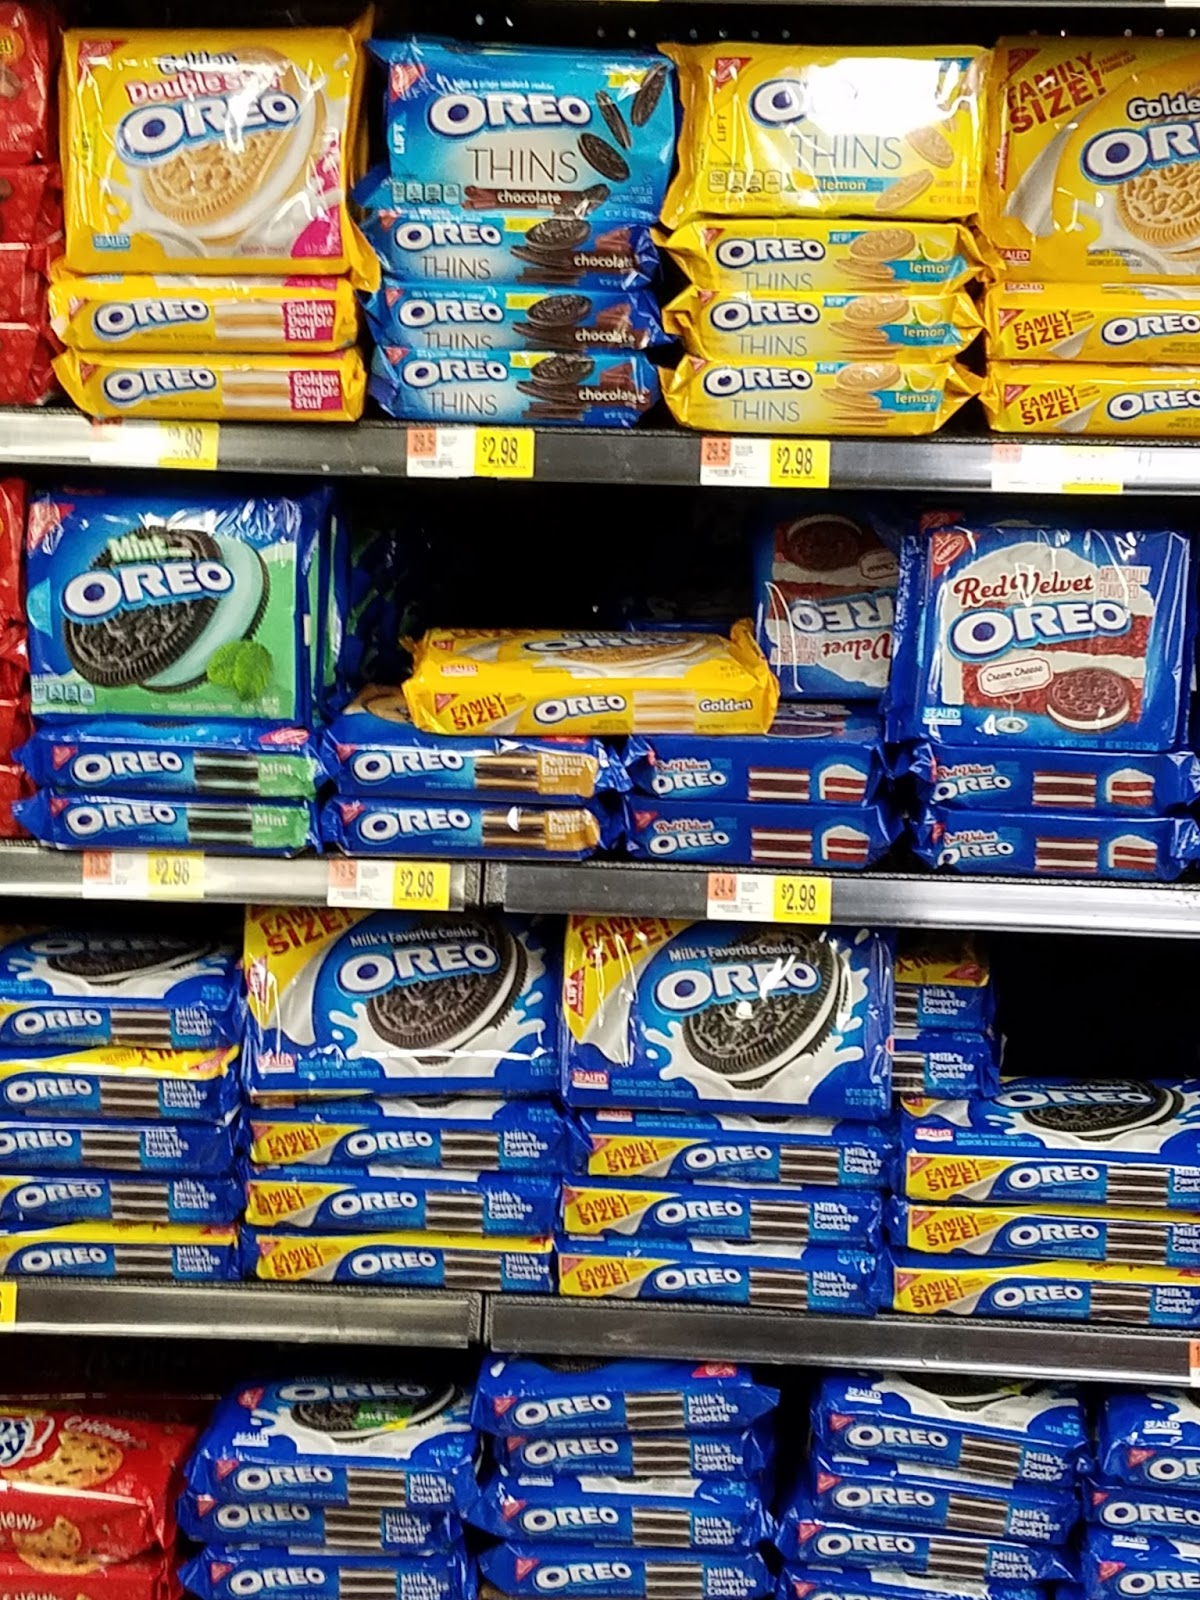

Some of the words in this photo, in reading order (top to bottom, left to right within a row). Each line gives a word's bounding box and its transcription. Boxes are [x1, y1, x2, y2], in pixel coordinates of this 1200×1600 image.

[127, 71, 223, 105] Double
[1006, 52, 1096, 110] FAMILY
[428, 91, 592, 137] OREO
[1010, 70, 1107, 134] SIZE!
[120, 93, 299, 155] OREO
[717, 115, 727, 142] LIFT
[392, 122, 406, 154] LIFT
[791, 133, 902, 171] THINS
[466, 147, 579, 184] THINS
[822, 179, 867, 191] lemon
[497, 190, 562, 206] chocolate
[396, 222, 501, 250] OREO
[716, 238, 826, 269] OREO
[421, 256, 492, 279] THINS
[742, 271, 813, 291] THINS
[94, 300, 210, 337] OREO
[287, 302, 333, 316] Golden
[288, 315, 334, 327] Double
[400, 299, 503, 327] OREO
[710, 302, 820, 332] OREO
[288, 326, 316, 340] Stuf
[903, 326, 946, 339] lemon
[1013, 310, 1071, 336] FAMILY
[1101, 314, 1200, 346] OREO
[422, 331, 493, 350] THINS
[737, 334, 808, 356] THINS
[1015, 321, 1075, 351] SIZE!
[104, 368, 217, 404] OREO
[292, 372, 339, 387] Golden
[403, 360, 508, 388] OREO
[703, 367, 813, 397] OREO
[294, 385, 340, 398] Double
[294, 397, 323, 410] Stuf
[427, 391, 498, 416] THINS
[895, 392, 937, 405] lemon
[1020, 385, 1077, 412] FAMILY
[730, 399, 801, 423] THINS
[1021, 396, 1081, 426] SIZE!
[482, 437, 519, 466] $2.98
[776, 445, 813, 476] $2.98
[108, 532, 167, 562] Mint
[62, 558, 235, 620] OREO
[953, 574, 1008, 607] Red
[1010, 570, 1094, 602] Velvet
[952, 601, 1130, 656] OREO
[822, 633, 892, 661] Velvet
[986, 668, 1014, 683] Cream
[1014, 664, 1044, 678] Cheese
[533, 694, 627, 724] OREO
[699, 698, 753, 713] Golden
[73, 751, 184, 784] OREO
[260, 761, 295, 775] Mint
[353, 749, 464, 782] OREO
[541, 754, 588, 768] Peanut
[541, 764, 584, 777] Butter
[652, 771, 727, 795] OREO
[931, 775, 1012, 804] OREO
[66, 804, 177, 837] OREO
[254, 813, 289, 827] Mint
[360, 807, 472, 842] OREO
[650, 831, 731, 855] OREO
[938, 843, 1015, 867] OREO
[155, 858, 191, 886] $2.98
[400, 870, 435, 899] $2.98
[781, 883, 817, 912] $2.98
[351, 934, 387, 949] Milk's
[389, 930, 438, 944] Favorite
[440, 926, 479, 940] Cookie
[669, 947, 707, 962] Milk's
[708, 944, 757, 958] Favorite
[758, 943, 801, 956] Cookie
[339, 943, 498, 994] OREO
[922, 988, 956, 999] Milk's
[922, 997, 967, 1008] Favorite
[14, 1008, 102, 1034] OREO
[922, 1005, 959, 1016] Cookie
[929, 1052, 964, 1064] Milk's
[929, 1061, 975, 1073] Favorite
[930, 1069, 966, 1080] Cookie
[6, 1079, 92, 1103] OREO
[996, 1090, 1152, 1108] OREO
[347, 1131, 433, 1157] OREO
[916, 1127, 953, 1138] SEALED
[604, 1139, 656, 1162] FAMILY
[607, 1149, 660, 1173] SIZE!
[685, 1145, 772, 1169] OREO
[925, 1159, 977, 1182] FAMILY
[927, 1169, 982, 1193] SIZE!
[1008, 1165, 1100, 1190] OREO
[16, 1184, 102, 1208] OREO
[331, 1192, 418, 1217] OREO
[576, 1193, 627, 1216] FAMILY
[578, 1203, 631, 1227] SIZE!
[655, 1201, 743, 1225] OREO
[813, 1202, 848, 1215] Milk's
[813, 1212, 859, 1224] Favorite
[813, 1221, 851, 1233] Cookie
[925, 1213, 977, 1236] FAMILY
[927, 1223, 981, 1247] SIZE!
[1009, 1224, 1100, 1248] OREO
[21, 1247, 107, 1273] OREO
[352, 1251, 437, 1277] OREO
[576, 1260, 627, 1283] FAMILY
[578, 1269, 631, 1293] SIZE!
[654, 1267, 742, 1292] OREO
[812, 1271, 846, 1283] Milk's
[812, 1280, 858, 1291] Favorite
[909, 1277, 961, 1299] FAMILY
[812, 1288, 850, 1299] Cookie
[912, 1286, 966, 1309] SIZE!
[993, 1285, 1083, 1308] OREO
[1156, 1287, 1191, 1299] Milk's
[1155, 1304, 1193, 1315] Cookie
[279, 1383, 427, 1401] OREO
[687, 1394, 725, 1407] Milk's
[514, 1395, 612, 1426] OREO
[688, 1404, 739, 1416] Favorite
[688, 1412, 731, 1424] Cookie
[846, 1424, 949, 1449] OREO
[1144, 1420, 1181, 1430] SEALED
[524, 1436, 619, 1465] OREO
[236, 1466, 334, 1492] OREO
[834, 1485, 936, 1509] OREO
[217, 1503, 311, 1529] OREO
[523, 1506, 619, 1533] OREO
[694, 1517, 731, 1530] Milk's
[1010, 1517, 1061, 1532] Favorite
[1012, 1508, 1050, 1523] Milk's
[816, 1533, 916, 1556] OREO
[1008, 1525, 1050, 1541] Cookie
[991, 1550, 1029, 1565] Milk's
[230, 1567, 326, 1594] OREO
[535, 1561, 632, 1590] OREO
[706, 1568, 744, 1581] Milk's
[706, 1577, 757, 1589] Favorite
[706, 1586, 749, 1598] Cookie
